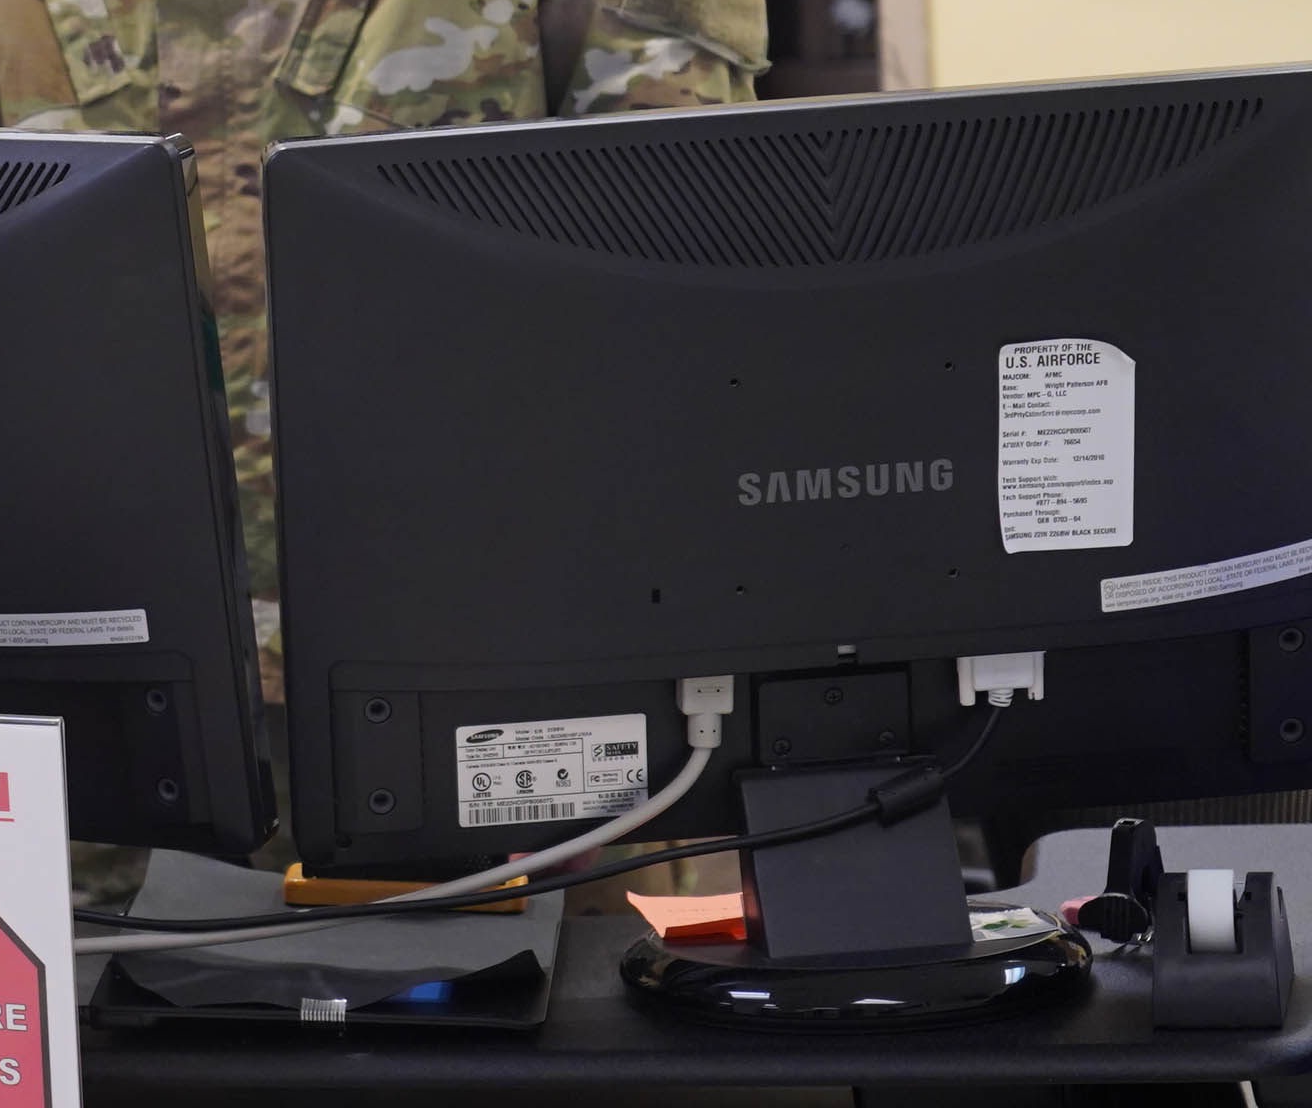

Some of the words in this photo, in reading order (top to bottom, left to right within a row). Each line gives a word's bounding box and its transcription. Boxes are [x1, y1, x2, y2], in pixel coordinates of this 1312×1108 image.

[1014, 344, 1059, 354] PROPERTY
[1062, 344, 1072, 352] OF
[1076, 343, 1093, 351] THE
[1006, 356, 1032, 369] U.S.
[1037, 352, 1101, 367] AIRFORCE
[738, 458, 954, 506] SAMSUNG
